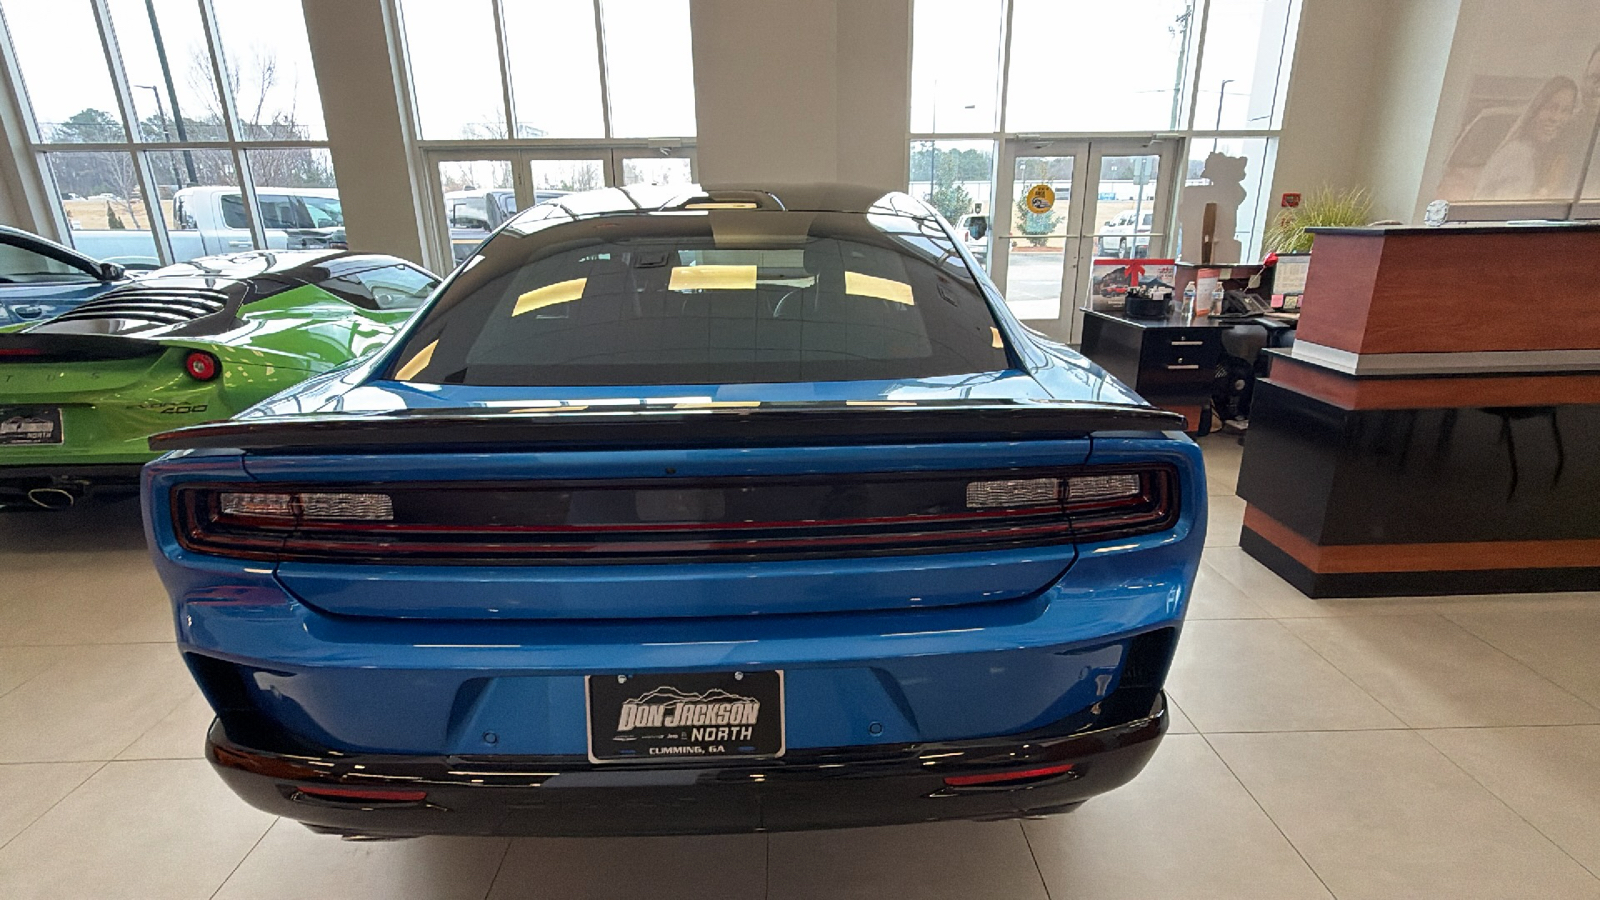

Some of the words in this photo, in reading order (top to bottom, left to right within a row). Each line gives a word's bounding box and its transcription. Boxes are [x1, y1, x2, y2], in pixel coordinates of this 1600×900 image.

[617, 703, 665, 732] DON
[664, 702, 760, 727] JACKSON
[691, 726, 753, 742] NORTH
[649, 745, 706, 755] CUMMING,
[708, 744, 726, 753] GA
